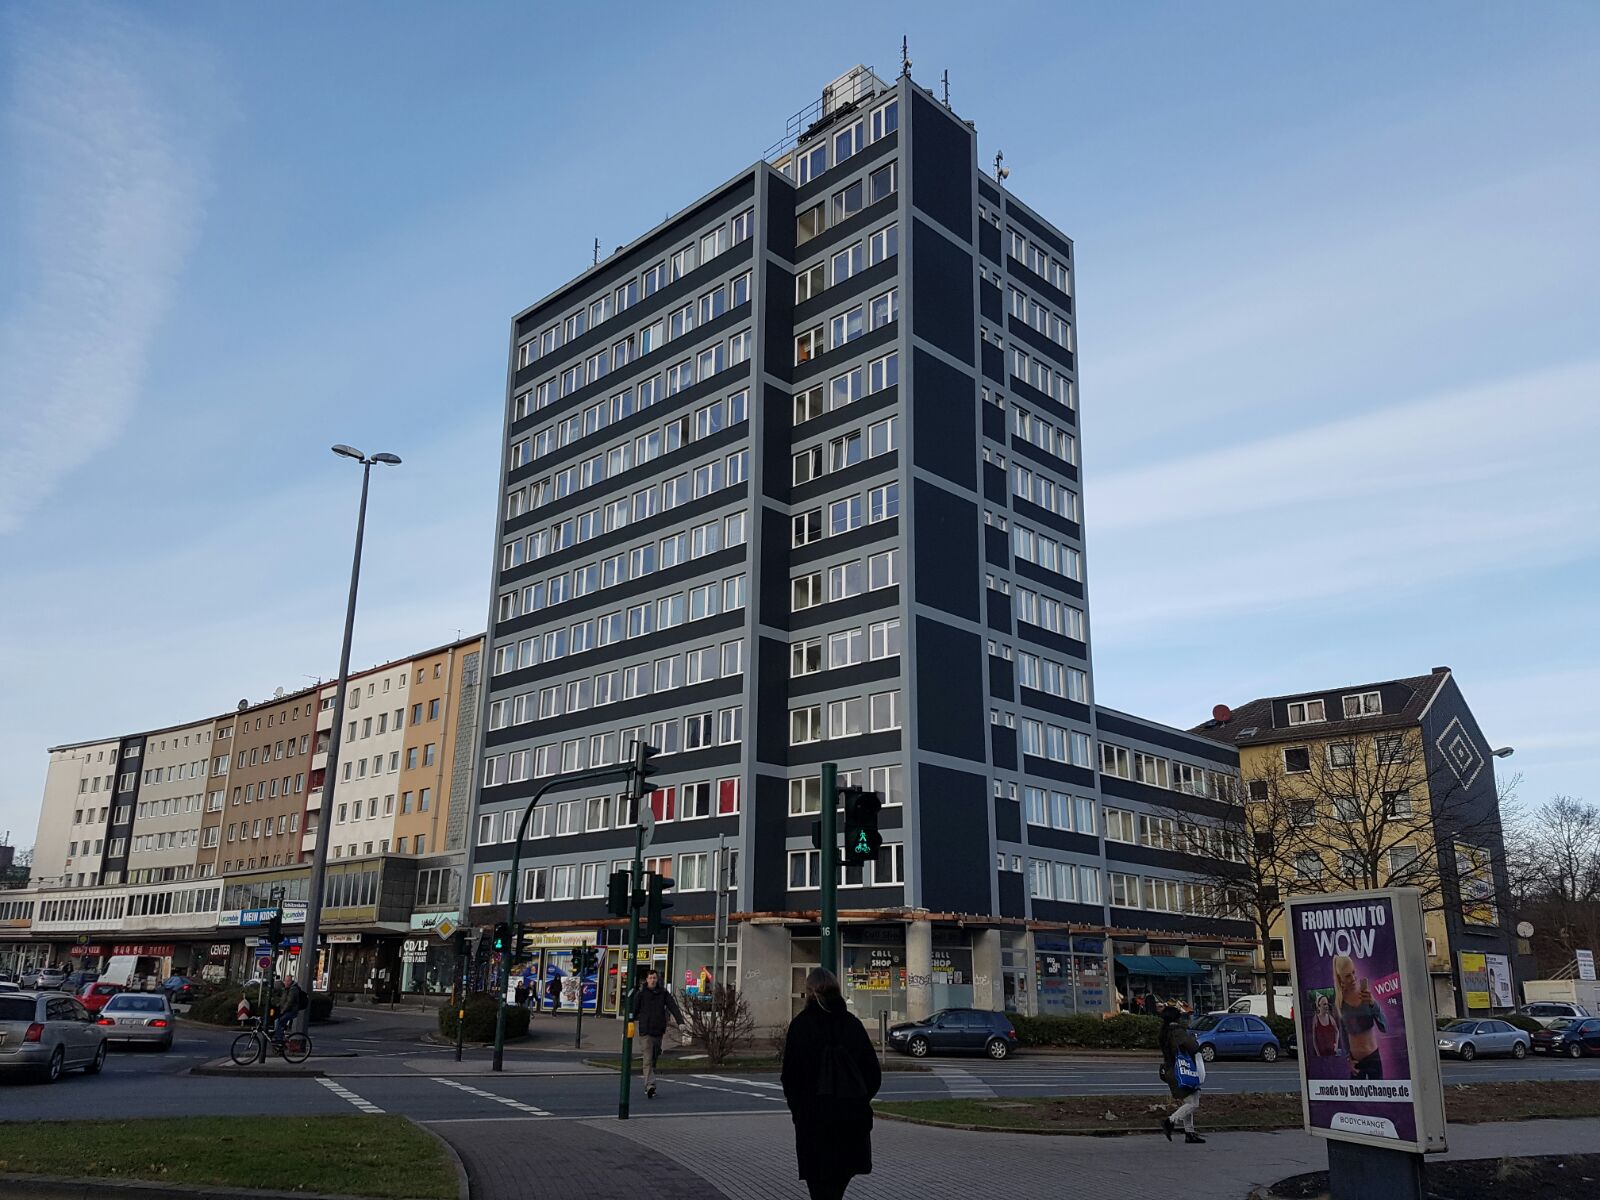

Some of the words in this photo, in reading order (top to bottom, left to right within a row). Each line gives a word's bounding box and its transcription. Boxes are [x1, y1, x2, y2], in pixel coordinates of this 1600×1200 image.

[243, 912, 258, 922] MEIN
[1301, 910, 1335, 930] FROM
[1336, 907, 1367, 928] NOW
[1369, 905, 1386, 925] TO
[210, 944, 231, 956] CENTER
[1314, 928, 1376, 959] WOW
[871, 950, 892, 958] CALL
[871, 959, 892, 968] SHOP
[1374, 977, 1398, 995] WOW
[1339, 1084, 1349, 1098] by
[1349, 1084, 1410, 1099] BodyChange.de
[1339, 1116, 1385, 1129] BODYCHANGE
